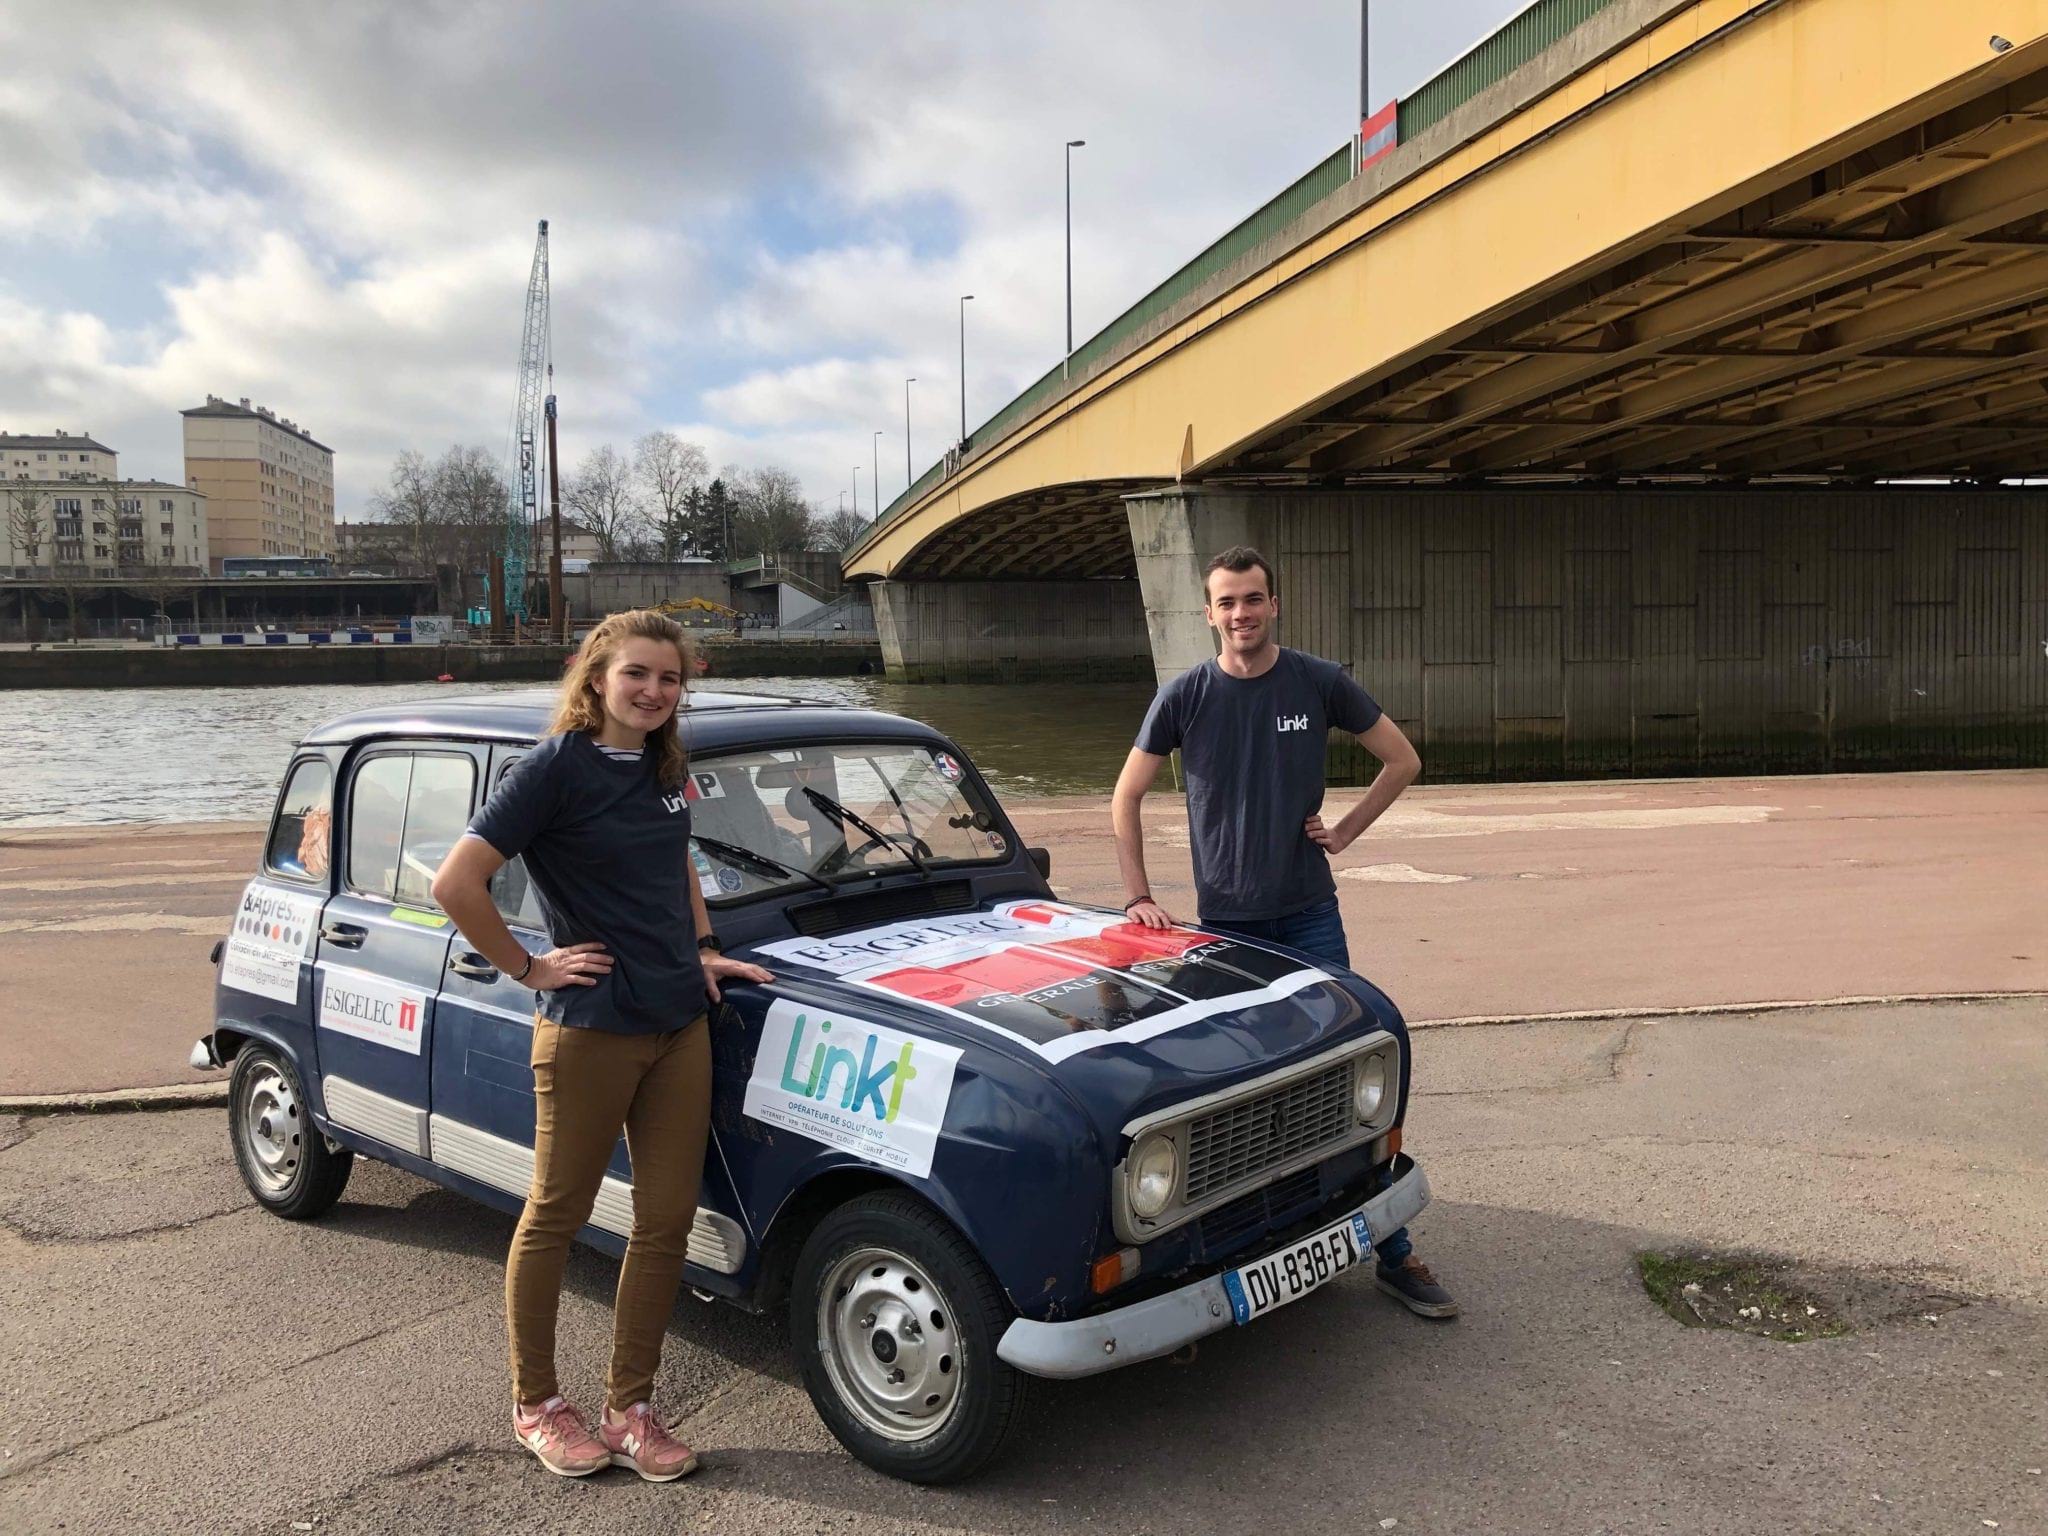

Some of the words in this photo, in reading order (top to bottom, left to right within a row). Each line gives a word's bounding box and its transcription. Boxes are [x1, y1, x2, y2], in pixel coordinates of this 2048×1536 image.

[1277, 714, 1309, 732] Linkt
[695, 773, 717, 797] P
[324, 986, 394, 1026] ESIGELEC
[781, 1014, 917, 1124] Linkt
[760, 1108, 786, 1122] INTERNET
[830, 1115, 840, 1125] DE
[841, 1119, 884, 1140] SOLUTIONS
[1238, 1304, 1244, 1317] F
